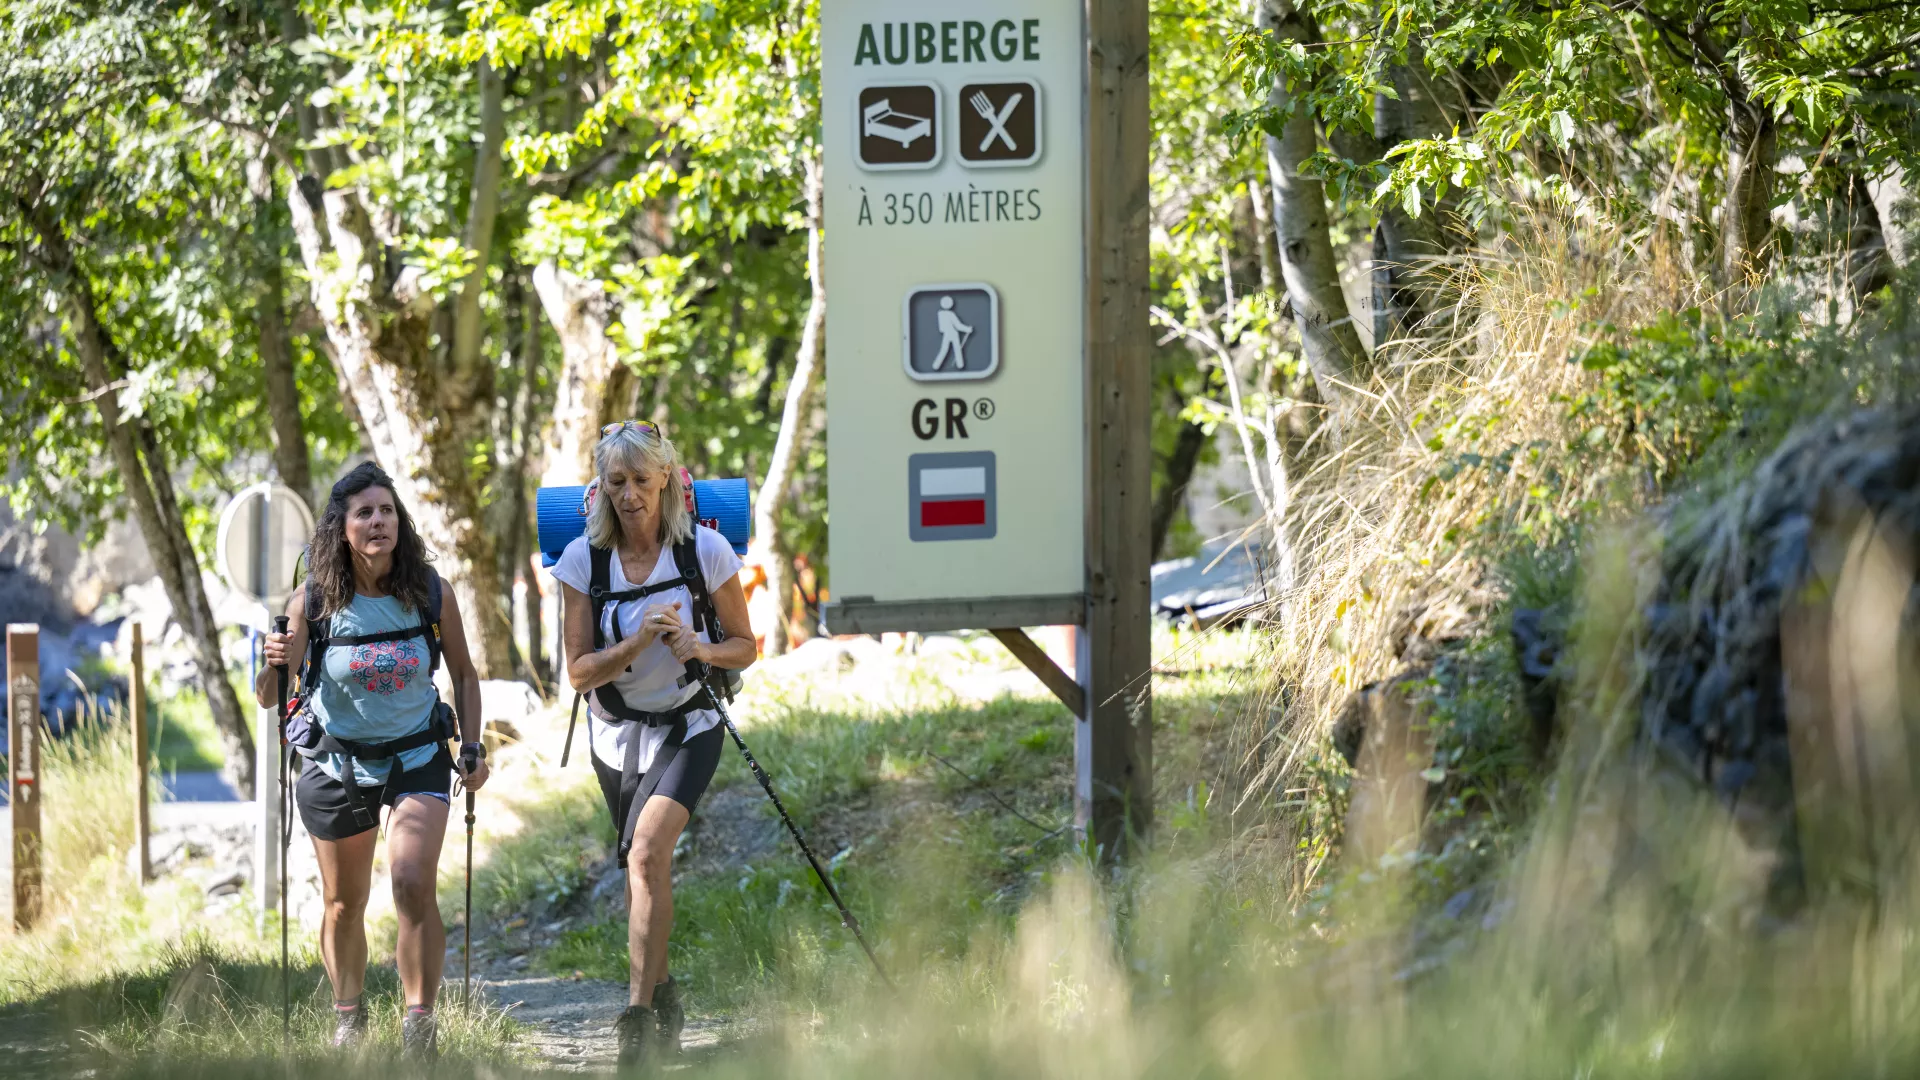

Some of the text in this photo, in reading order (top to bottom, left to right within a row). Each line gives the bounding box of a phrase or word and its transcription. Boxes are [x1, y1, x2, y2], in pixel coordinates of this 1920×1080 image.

[854, 19, 1040, 66] AUBERGE
[858, 183, 1041, 226] À 350 MÈTRES
